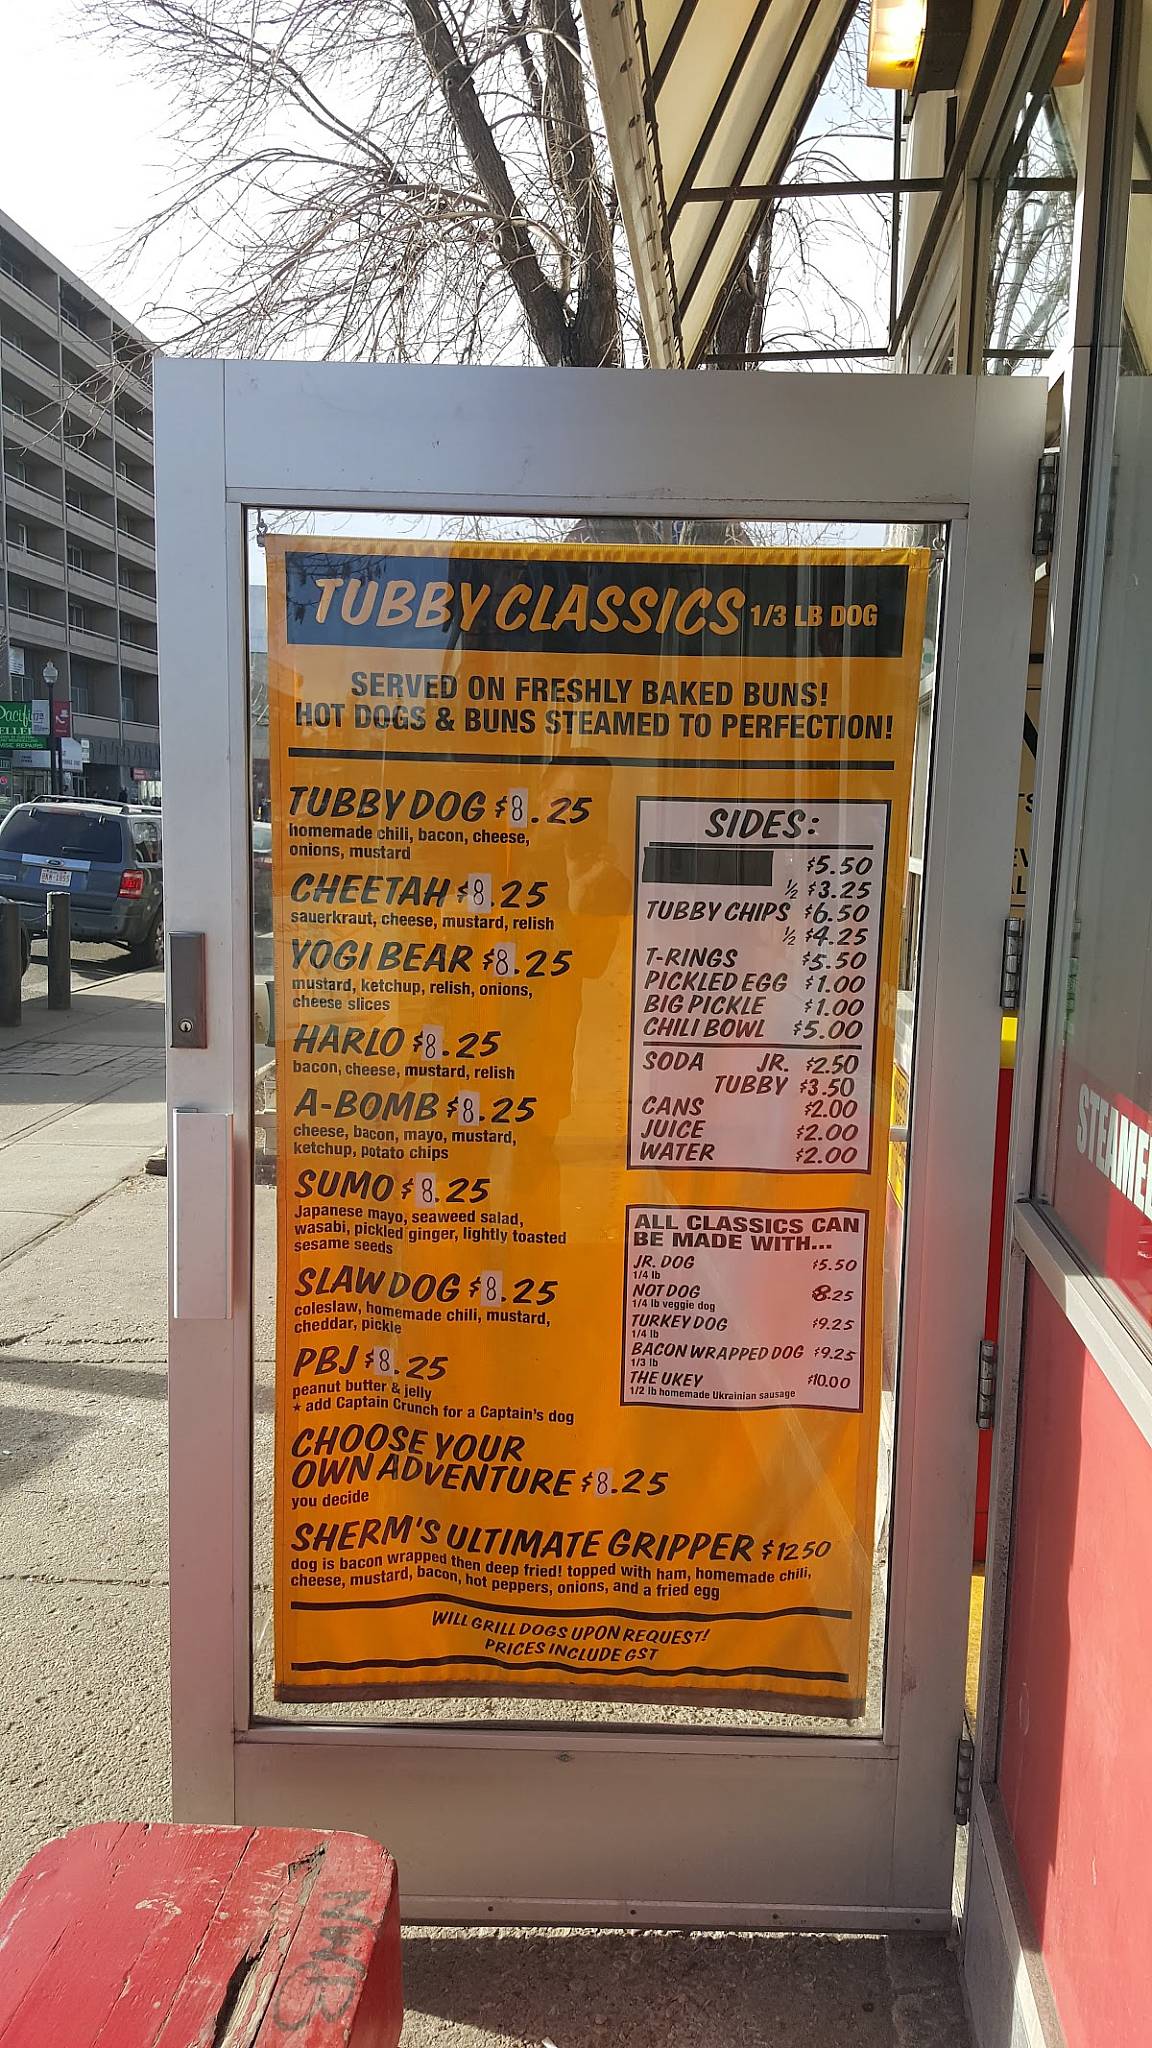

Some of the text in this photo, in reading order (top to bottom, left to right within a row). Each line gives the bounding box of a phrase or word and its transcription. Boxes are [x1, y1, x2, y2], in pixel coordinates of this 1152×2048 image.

[315, 578, 878, 637] TUBBY CLASSICS 1/3 LB DOG
[351, 671, 828, 706] SERVED ON FRESHLY BAKED BUNS!
[296, 702, 893, 740] HOT DOGS & BUNS STEAMED TO PERFECTION!
[289, 786, 592, 824] TUBBY DOG $8.25
[289, 823, 530, 846] homemade chili, bacon, cheese,
[705, 808, 820, 839] SIDES:
[290, 844, 411, 860] onions, mustard
[807, 855, 873, 875] $5.50
[290, 873, 548, 909] CHEETAH $8.25
[808, 881, 872, 899] $3.25
[291, 911, 554, 931] sauerkraut, cheese, mustard, relish
[647, 900, 870, 924] TUBBY CHIPS $6.50
[805, 925, 869, 946] $4.25
[291, 938, 573, 977] YOGI BEAR $8.25
[646, 948, 867, 971] T-RINGS $5.50
[644, 971, 865, 994] PICKLED EGG $1.00
[644, 994, 865, 1016] BIG PICKLE $1.00
[643, 1017, 863, 1039] CHILI BOWL $5.00
[293, 1024, 501, 1059] HARLO $8.25
[643, 1051, 859, 1074] SODA JR. $2.50
[714, 1075, 855, 1097] TUBBY $3.50
[293, 1088, 537, 1124] A-BOMB $8.25
[641, 1096, 858, 1118] CANS $2.00
[640, 1120, 858, 1142] JUICE $2.00
[639, 1142, 858, 1164] WATER $2.00
[1076, 1083, 1152, 1222] STEAME
[294, 1169, 490, 1203] SUMO $8.25
[294, 1206, 524, 1227] Japanese mayo, seaweed salad,
[635, 1214, 859, 1234] ALL CLASSICS CAN
[634, 1232, 832, 1251] BE MADE WITH...
[633, 1255, 857, 1271] JR. DOG $5.50
[294, 1265, 558, 1306] SLAW DOG $8.25
[633, 1270, 661, 1280] 1/4 lb
[632, 1284, 665, 1297] NOT
[667, 1284, 701, 1298] DOG
[632, 1299, 715, 1312] 1/4 lb veggie dog
[632, 1314, 855, 1331] TURKEY DOG $9.25
[632, 1342, 856, 1361] BACON WRAPPED DOG $9.25
[293, 1345, 448, 1381] PBJ $8.25
[293, 1379, 432, 1401] peanut butter & jelly
[629, 1370, 850, 1389] THE UKEY $10.00
[630, 1386, 796, 1400] 1/2 lb homemade Ukrainian sausage
[306, 1396, 574, 1425] add Captain Crunch for a Captain's dog
[292, 1424, 525, 1463] CHOOSE YOUR
[291, 1453, 669, 1497] OWN ADVENTURE $8.25
[292, 1490, 369, 1510] you decide
[291, 1515, 441, 1552] SHERM'S
[447, 1523, 603, 1560] ULTIMATE
[608, 1528, 755, 1562] GRIPPER
[432, 1610, 710, 1644] WILL GRILL DOGS UPON REQUEST!
[485, 1638, 659, 1662] PRICES INCLUDE GST
